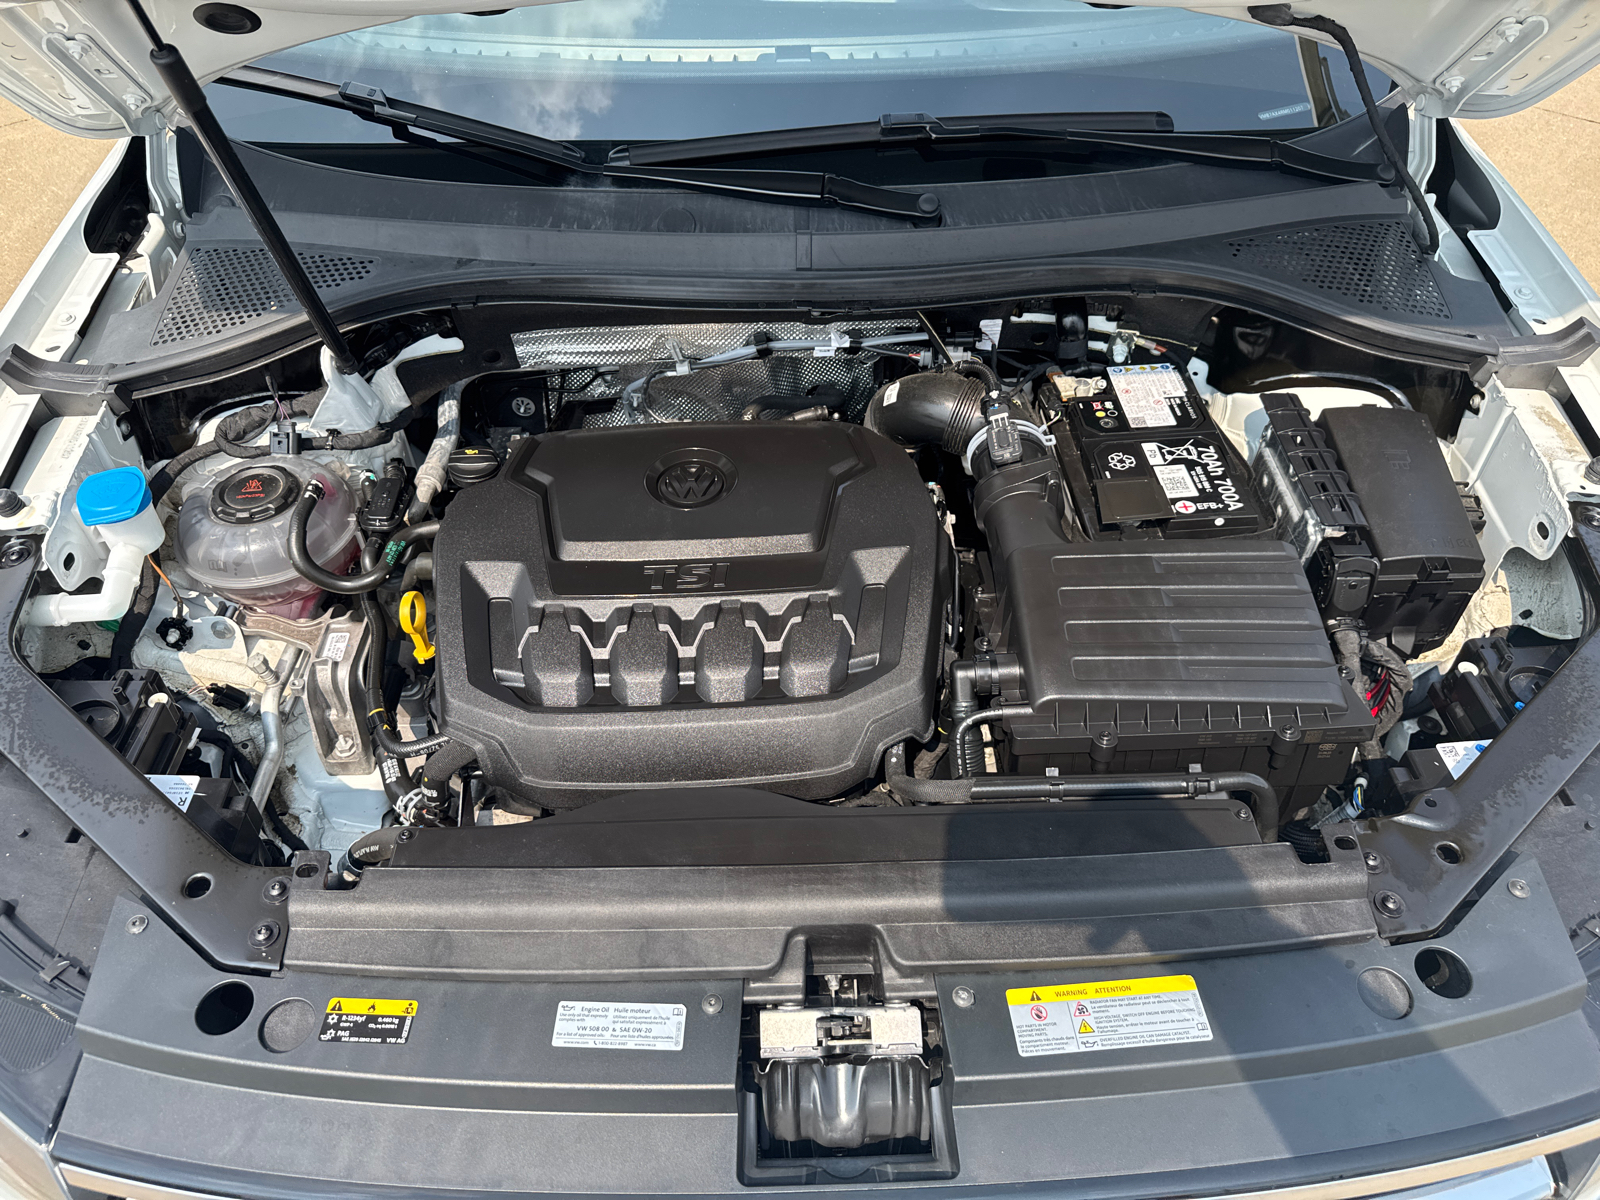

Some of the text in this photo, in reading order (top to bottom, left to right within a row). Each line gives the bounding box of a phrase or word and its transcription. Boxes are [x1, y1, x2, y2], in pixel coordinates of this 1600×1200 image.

[1198, 446, 1225, 476] 70Ah
[1214, 478, 1244, 511] 700A
[1196, 502, 1224, 510] EFB+
[644, 562, 730, 590] TSI
[178, 796, 188, 806] R
[1054, 986, 1132, 998] WARNING ATTENTION
[342, 1015, 366, 1023] R-1234yf
